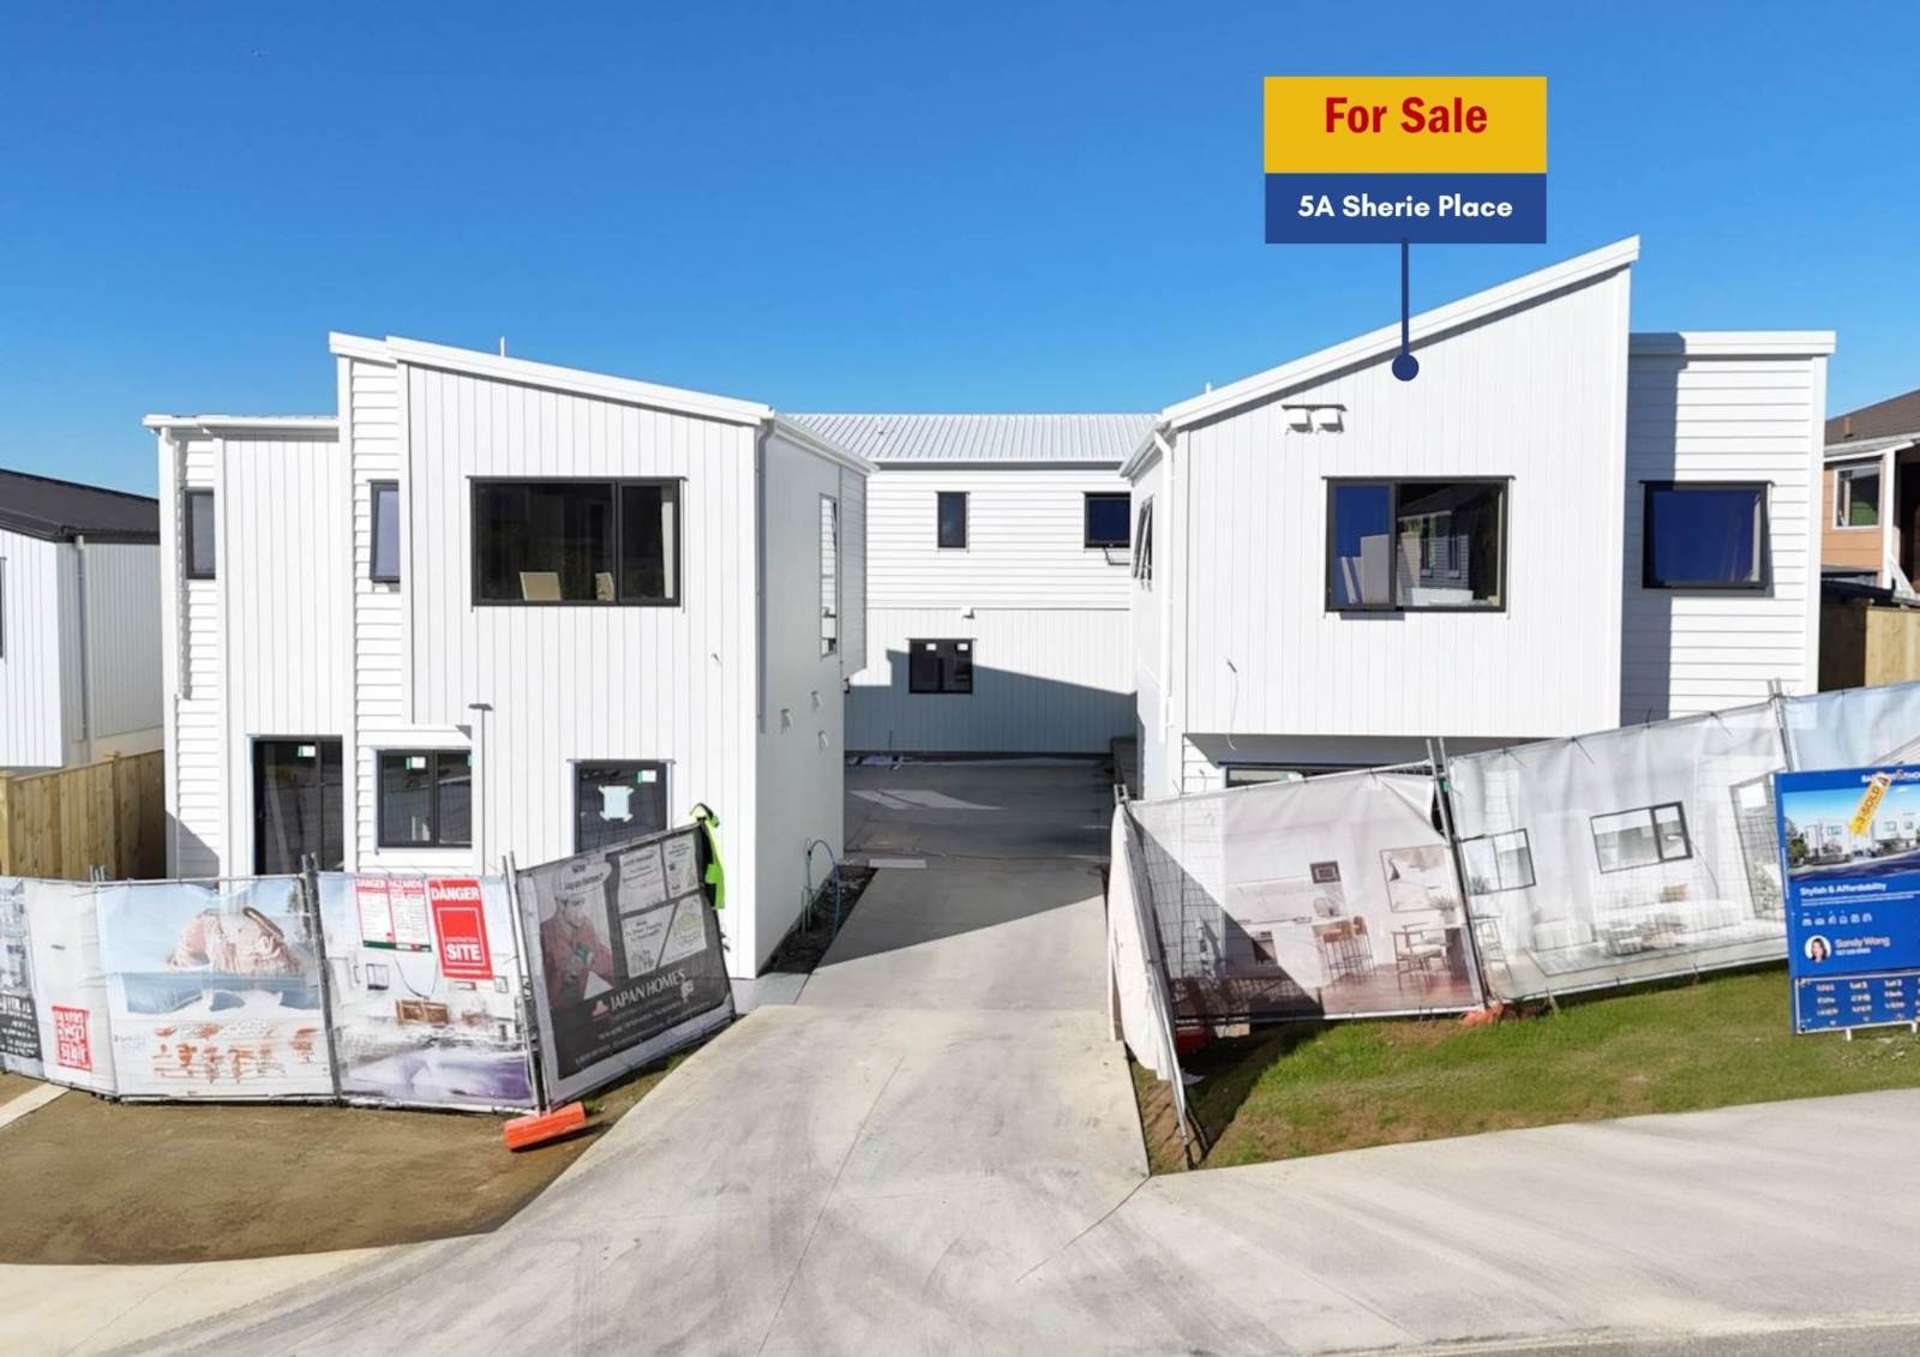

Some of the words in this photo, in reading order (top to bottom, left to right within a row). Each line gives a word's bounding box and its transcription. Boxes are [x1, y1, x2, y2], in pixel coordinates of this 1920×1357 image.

[431, 886, 480, 901] DANGER
[446, 943, 481, 961] SITE
[610, 984, 646, 1012] JAPAN
[646, 968, 686, 997] HOMES
